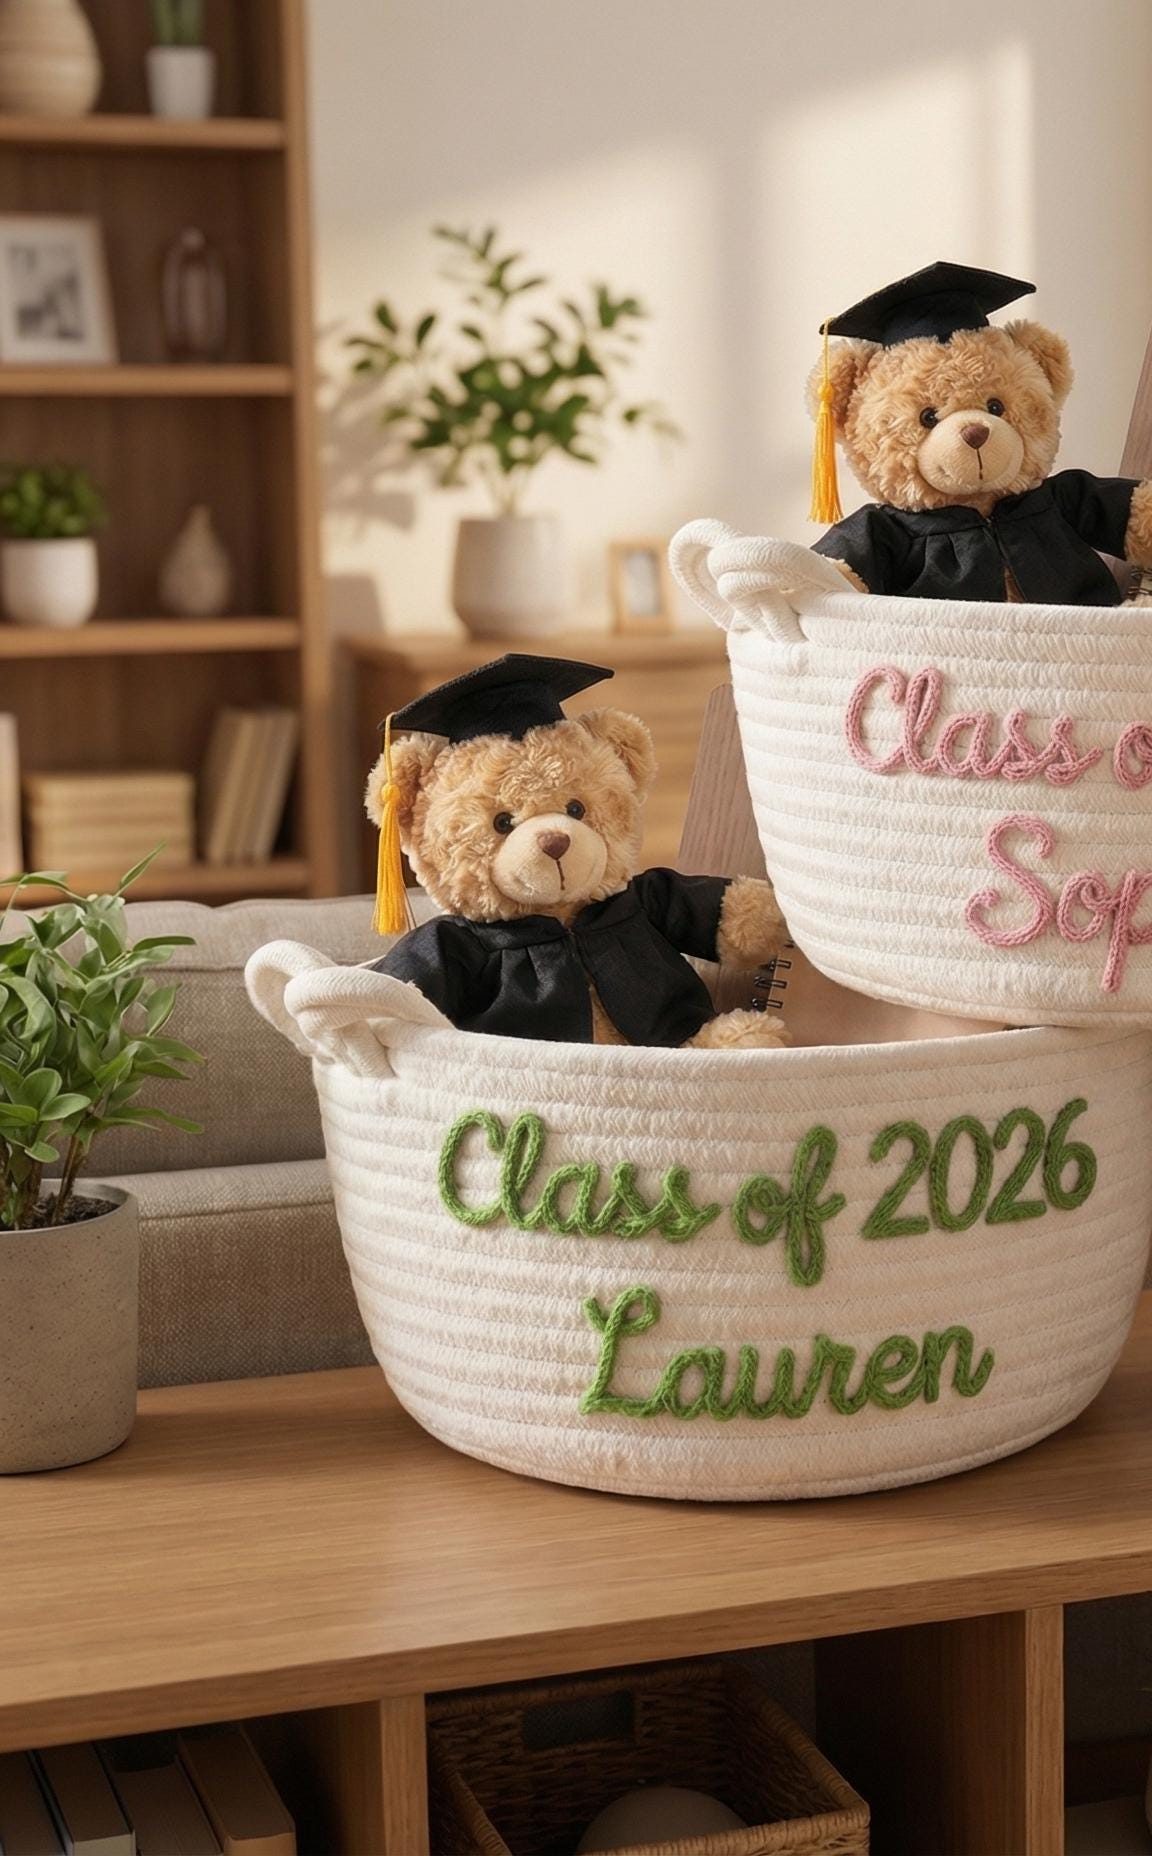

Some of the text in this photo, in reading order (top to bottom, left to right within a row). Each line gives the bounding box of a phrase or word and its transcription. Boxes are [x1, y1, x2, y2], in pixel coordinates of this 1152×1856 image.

[844, 666, 1101, 787] Class
[438, 1098, 1098, 1286] Class of 2026
[579, 1285, 994, 1419] Lauren
